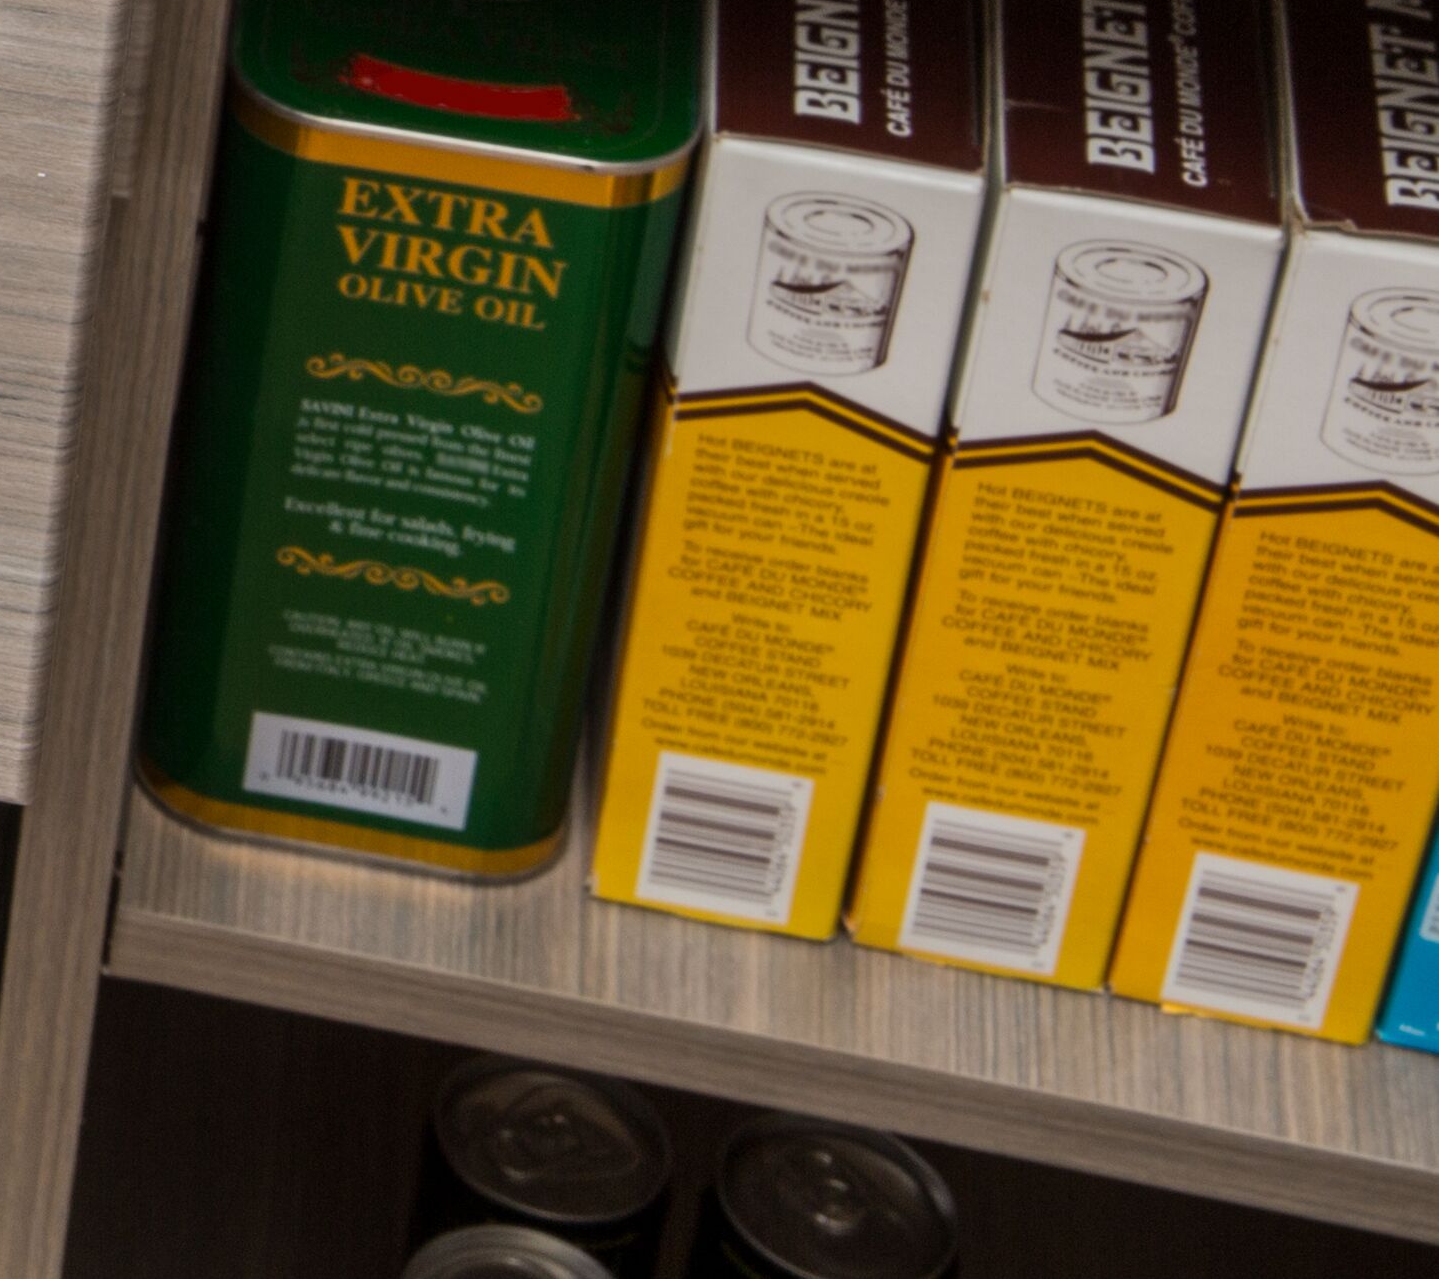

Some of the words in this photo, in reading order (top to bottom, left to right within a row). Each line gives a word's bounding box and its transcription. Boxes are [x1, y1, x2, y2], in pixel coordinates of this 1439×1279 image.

[886, 58, 910, 87] DU
[880, 87, 913, 137] CAFÉ
[1179, 106, 1204, 136] DU
[1368, 22, 1439, 209] BEIGNET
[1175, 137, 1208, 187] CAFÉ
[337, 176, 554, 249] EXTRA
[337, 225, 567, 299] VIRGIN
[338, 273, 464, 315] OLIVE
[475, 296, 546, 330] OIL
